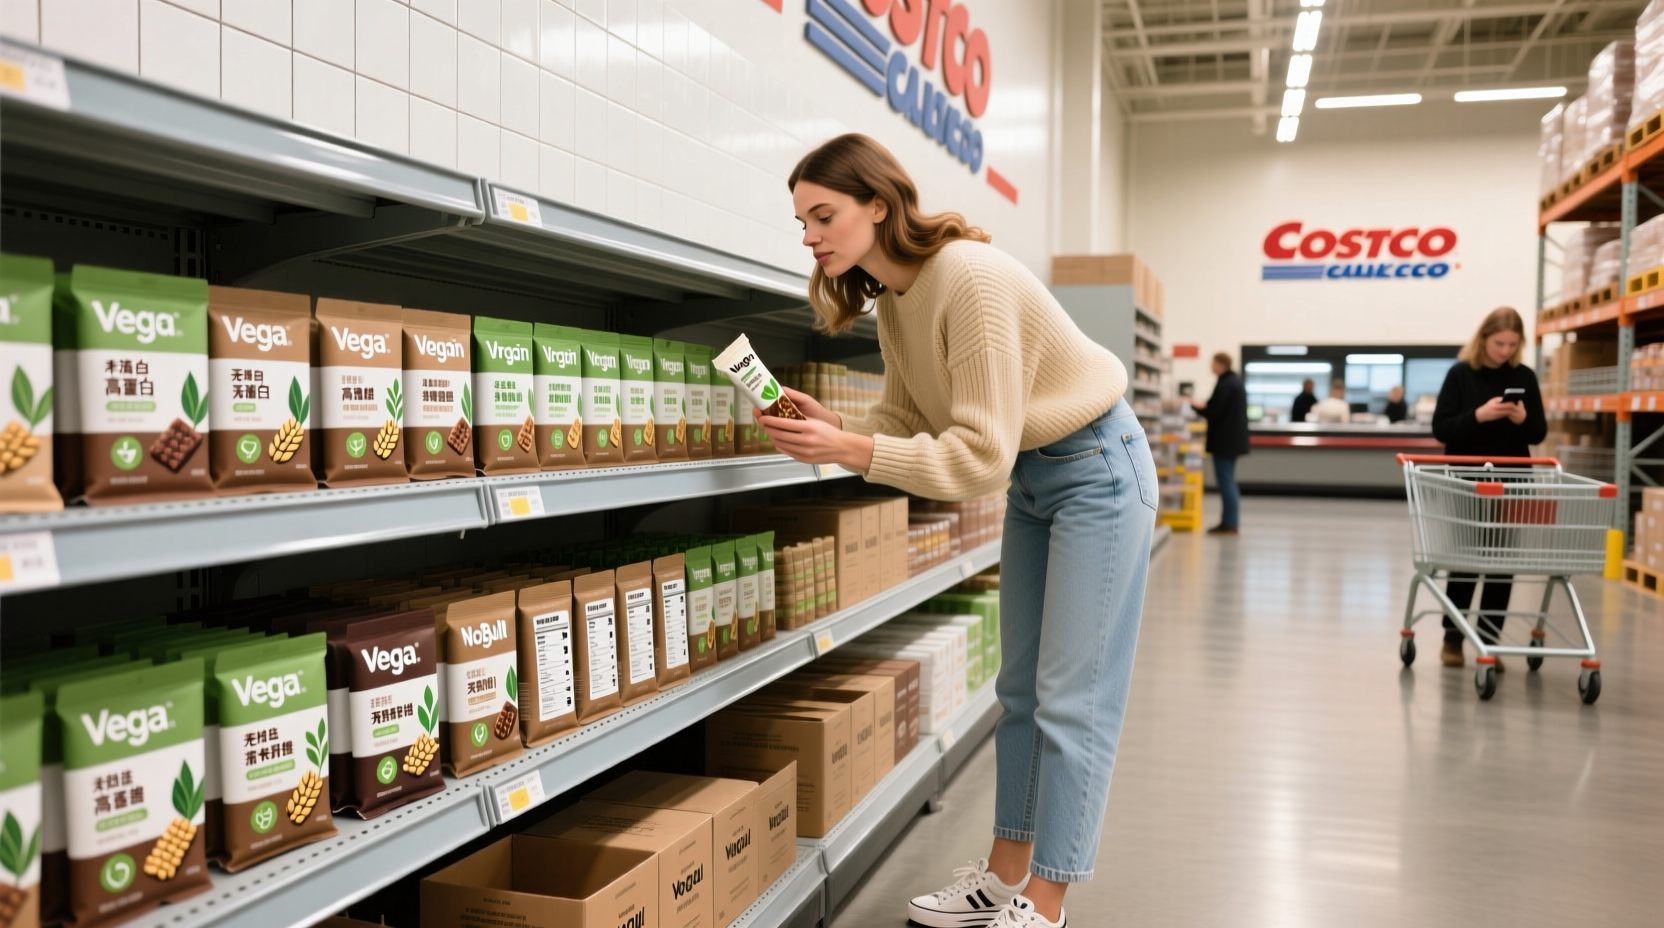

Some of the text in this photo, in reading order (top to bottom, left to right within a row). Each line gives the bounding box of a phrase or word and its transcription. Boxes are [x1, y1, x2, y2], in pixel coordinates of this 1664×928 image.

[860, 0, 991, 118] TCO
[91, 300, 176, 344] Vega
[222, 315, 288, 352] Vega
[331, 326, 387, 360] Vega
[361, 644, 418, 675] Vega
[231, 673, 302, 709] Vega
[80, 704, 169, 747] Vega
